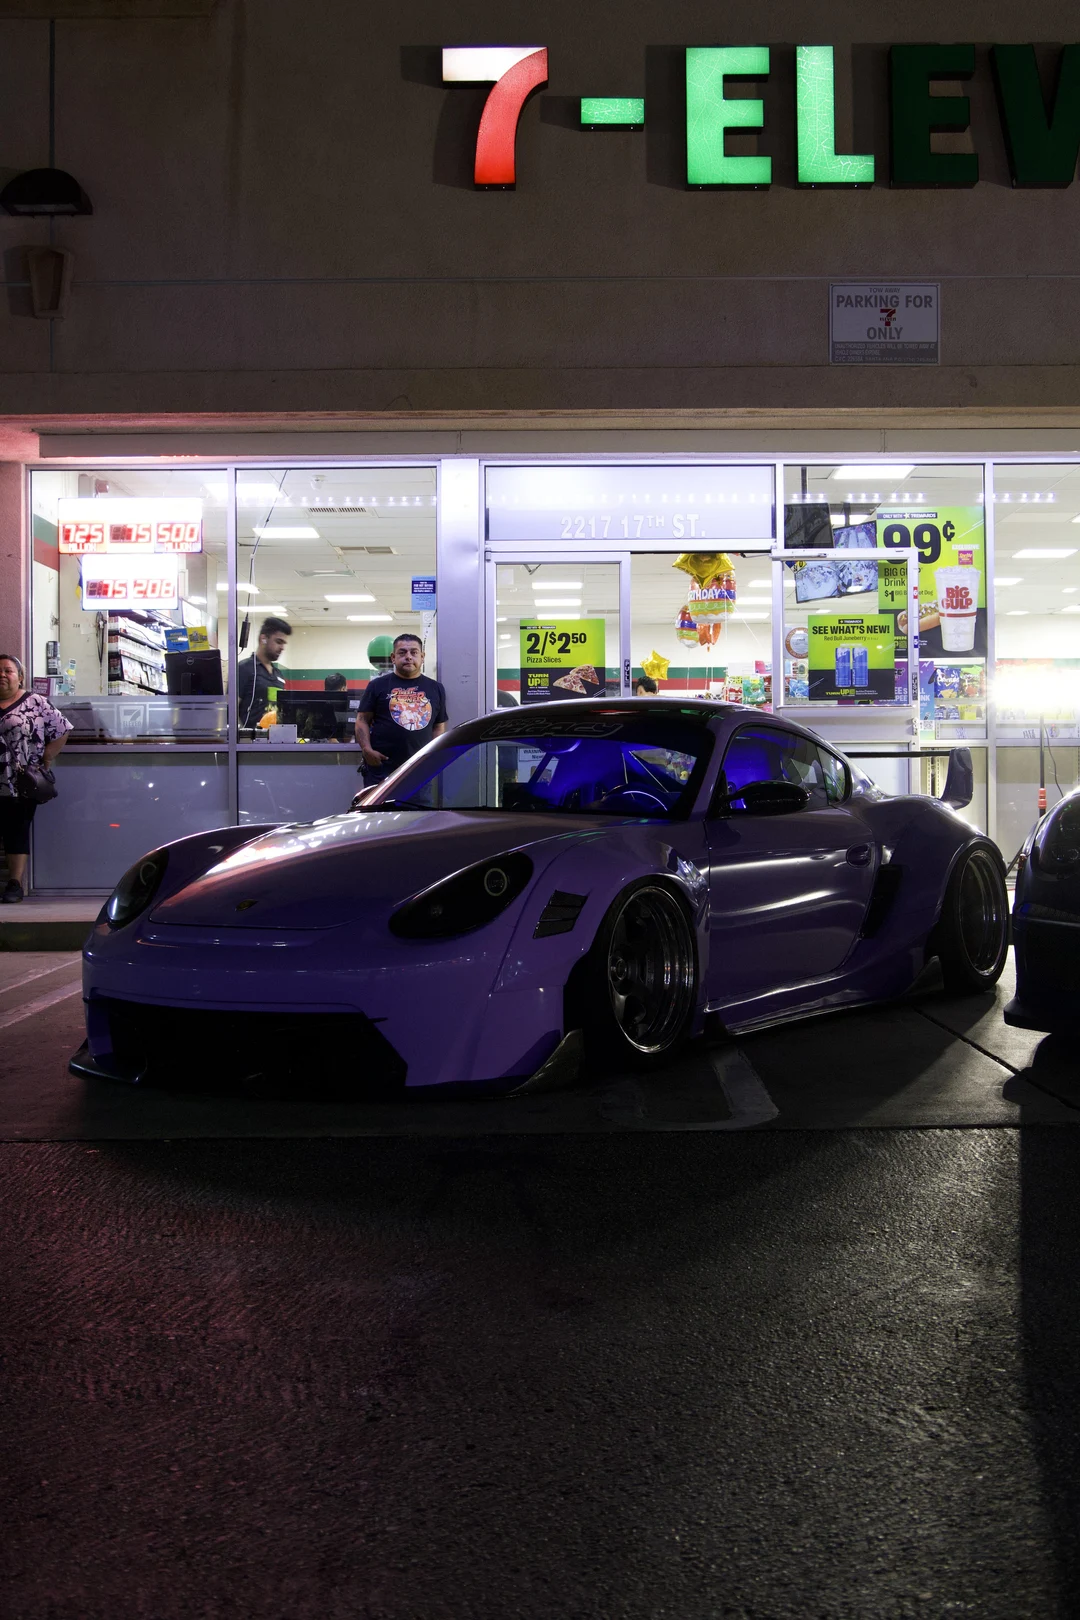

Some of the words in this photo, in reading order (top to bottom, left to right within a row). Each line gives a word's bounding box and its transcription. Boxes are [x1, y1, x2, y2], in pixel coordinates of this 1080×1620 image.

[836, 295, 900, 308] PARKING
[905, 295, 933, 308] FOR
[866, 327, 903, 340] ONLY
[560, 515, 612, 539] 2217
[620, 515, 665, 538] 17TH
[672, 513, 706, 539] ST.
[64, 524, 103, 543] 725
[157, 523, 199, 543] 500
[884, 568, 898, 576] BIG
[133, 579, 174, 598] 208
[884, 578, 906, 587] Drink
[884, 590, 895, 602] $1
[941, 598, 973, 609] GULP
[812, 626, 828, 635] SEE
[830, 625, 865, 635] WHAT'S
[866, 625, 890, 634] NEW!
[527, 678, 541, 687] UP
